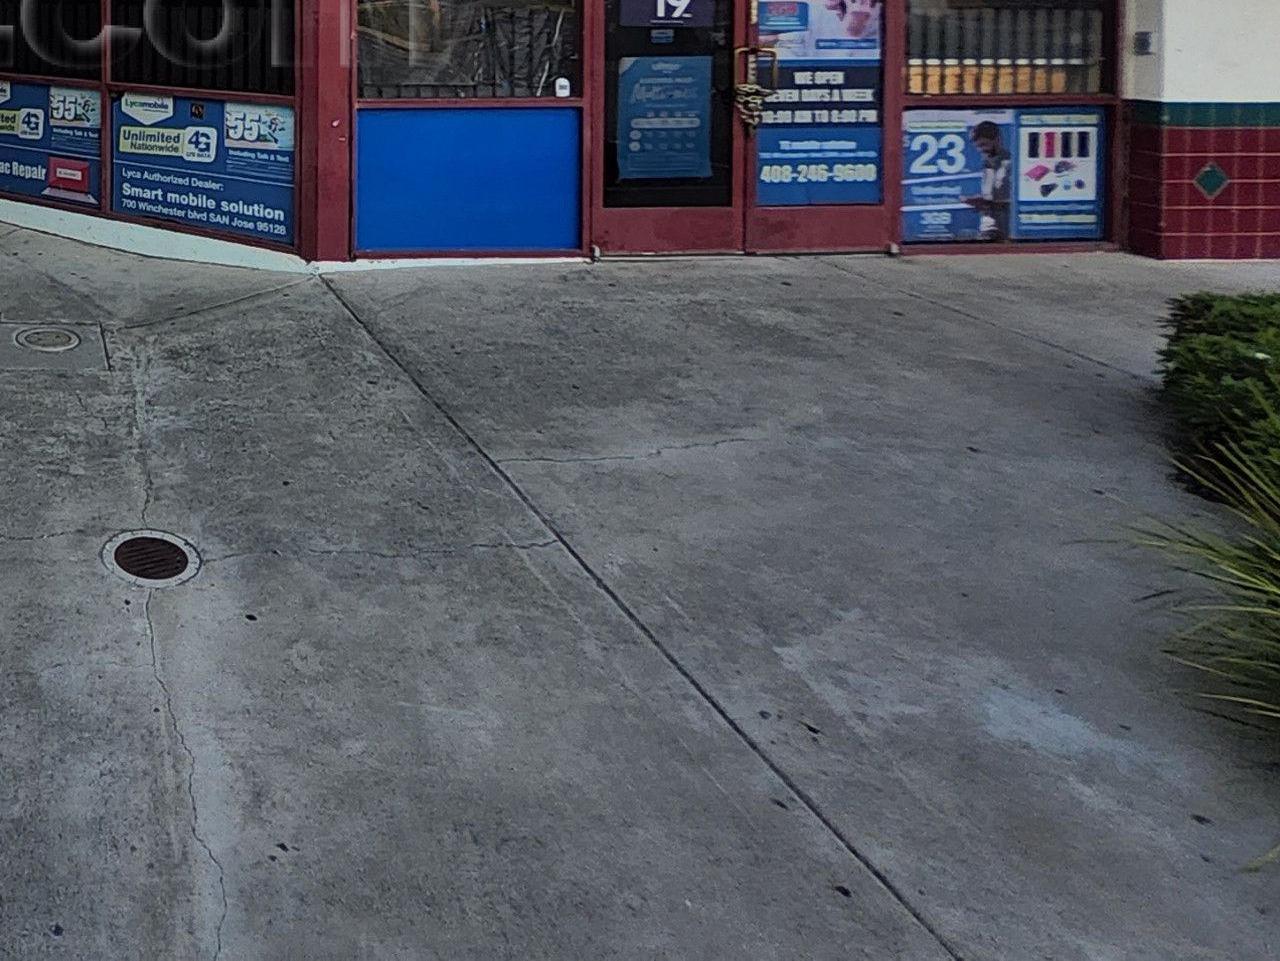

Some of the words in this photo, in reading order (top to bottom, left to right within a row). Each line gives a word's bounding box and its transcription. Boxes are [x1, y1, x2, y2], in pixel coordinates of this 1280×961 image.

[124, 98, 169, 110] Lycamobile
[22, 111, 40, 131] 4G
[122, 129, 180, 144] Unlimited
[187, 130, 211, 152] 4G
[130, 141, 179, 153] Nationwide
[12, 160, 47, 180] Repair
[122, 166, 141, 180] Lyca
[143, 169, 189, 186] Authorized
[191, 176, 224, 191] Dealer:
[122, 182, 163, 201] Smart
[167, 190, 216, 209] mobile
[220, 200, 284, 222] solution
[122, 198, 136, 209] 700
[138, 200, 186, 218] Winchester
[187, 209, 207, 221] blvd
[209, 213, 229, 225] SAN
[231, 216, 254, 230] Jose
[256, 220, 287, 235] 95128
